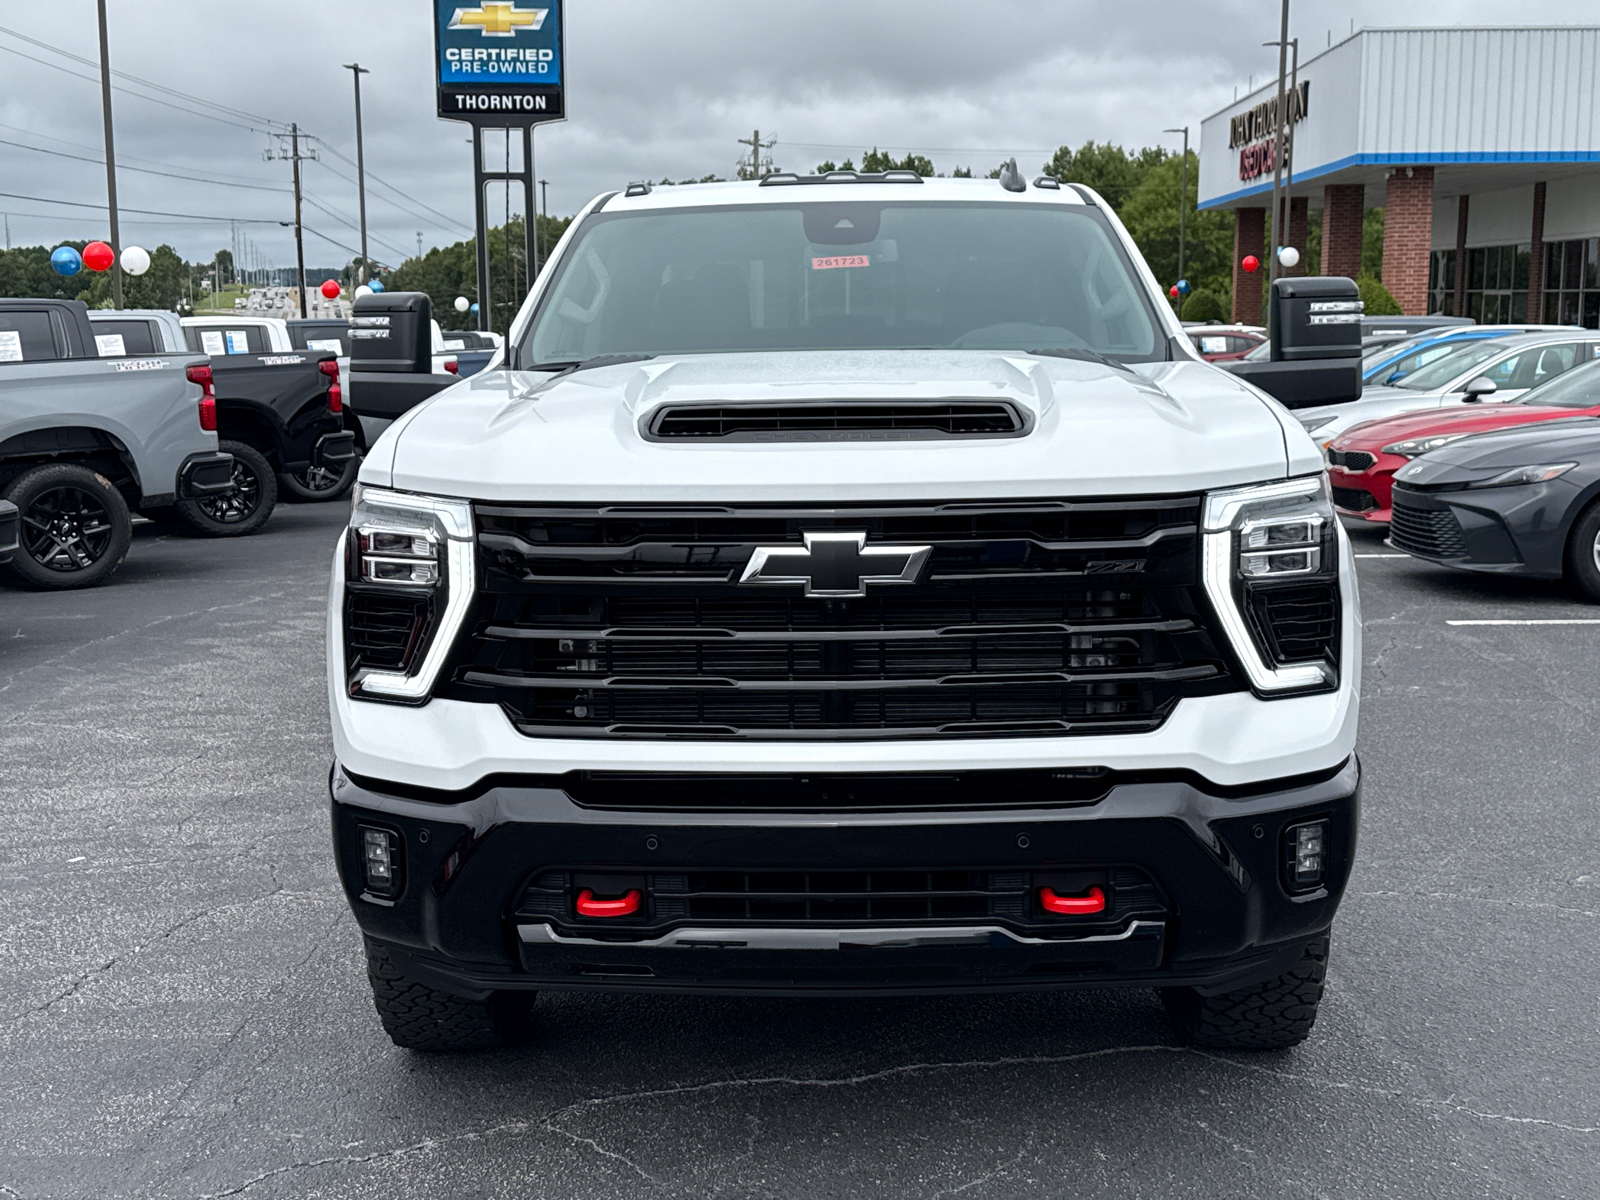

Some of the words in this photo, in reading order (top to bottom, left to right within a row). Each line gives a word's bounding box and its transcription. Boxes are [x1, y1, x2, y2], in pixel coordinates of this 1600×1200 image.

[445, 48, 553, 61] CERTIFIED
[451, 61, 548, 74] PRE-OWNED
[455, 94, 547, 110] THORNTON
[816, 256, 865, 267] 261723
[753, 431, 918, 441] CHEVROLET
